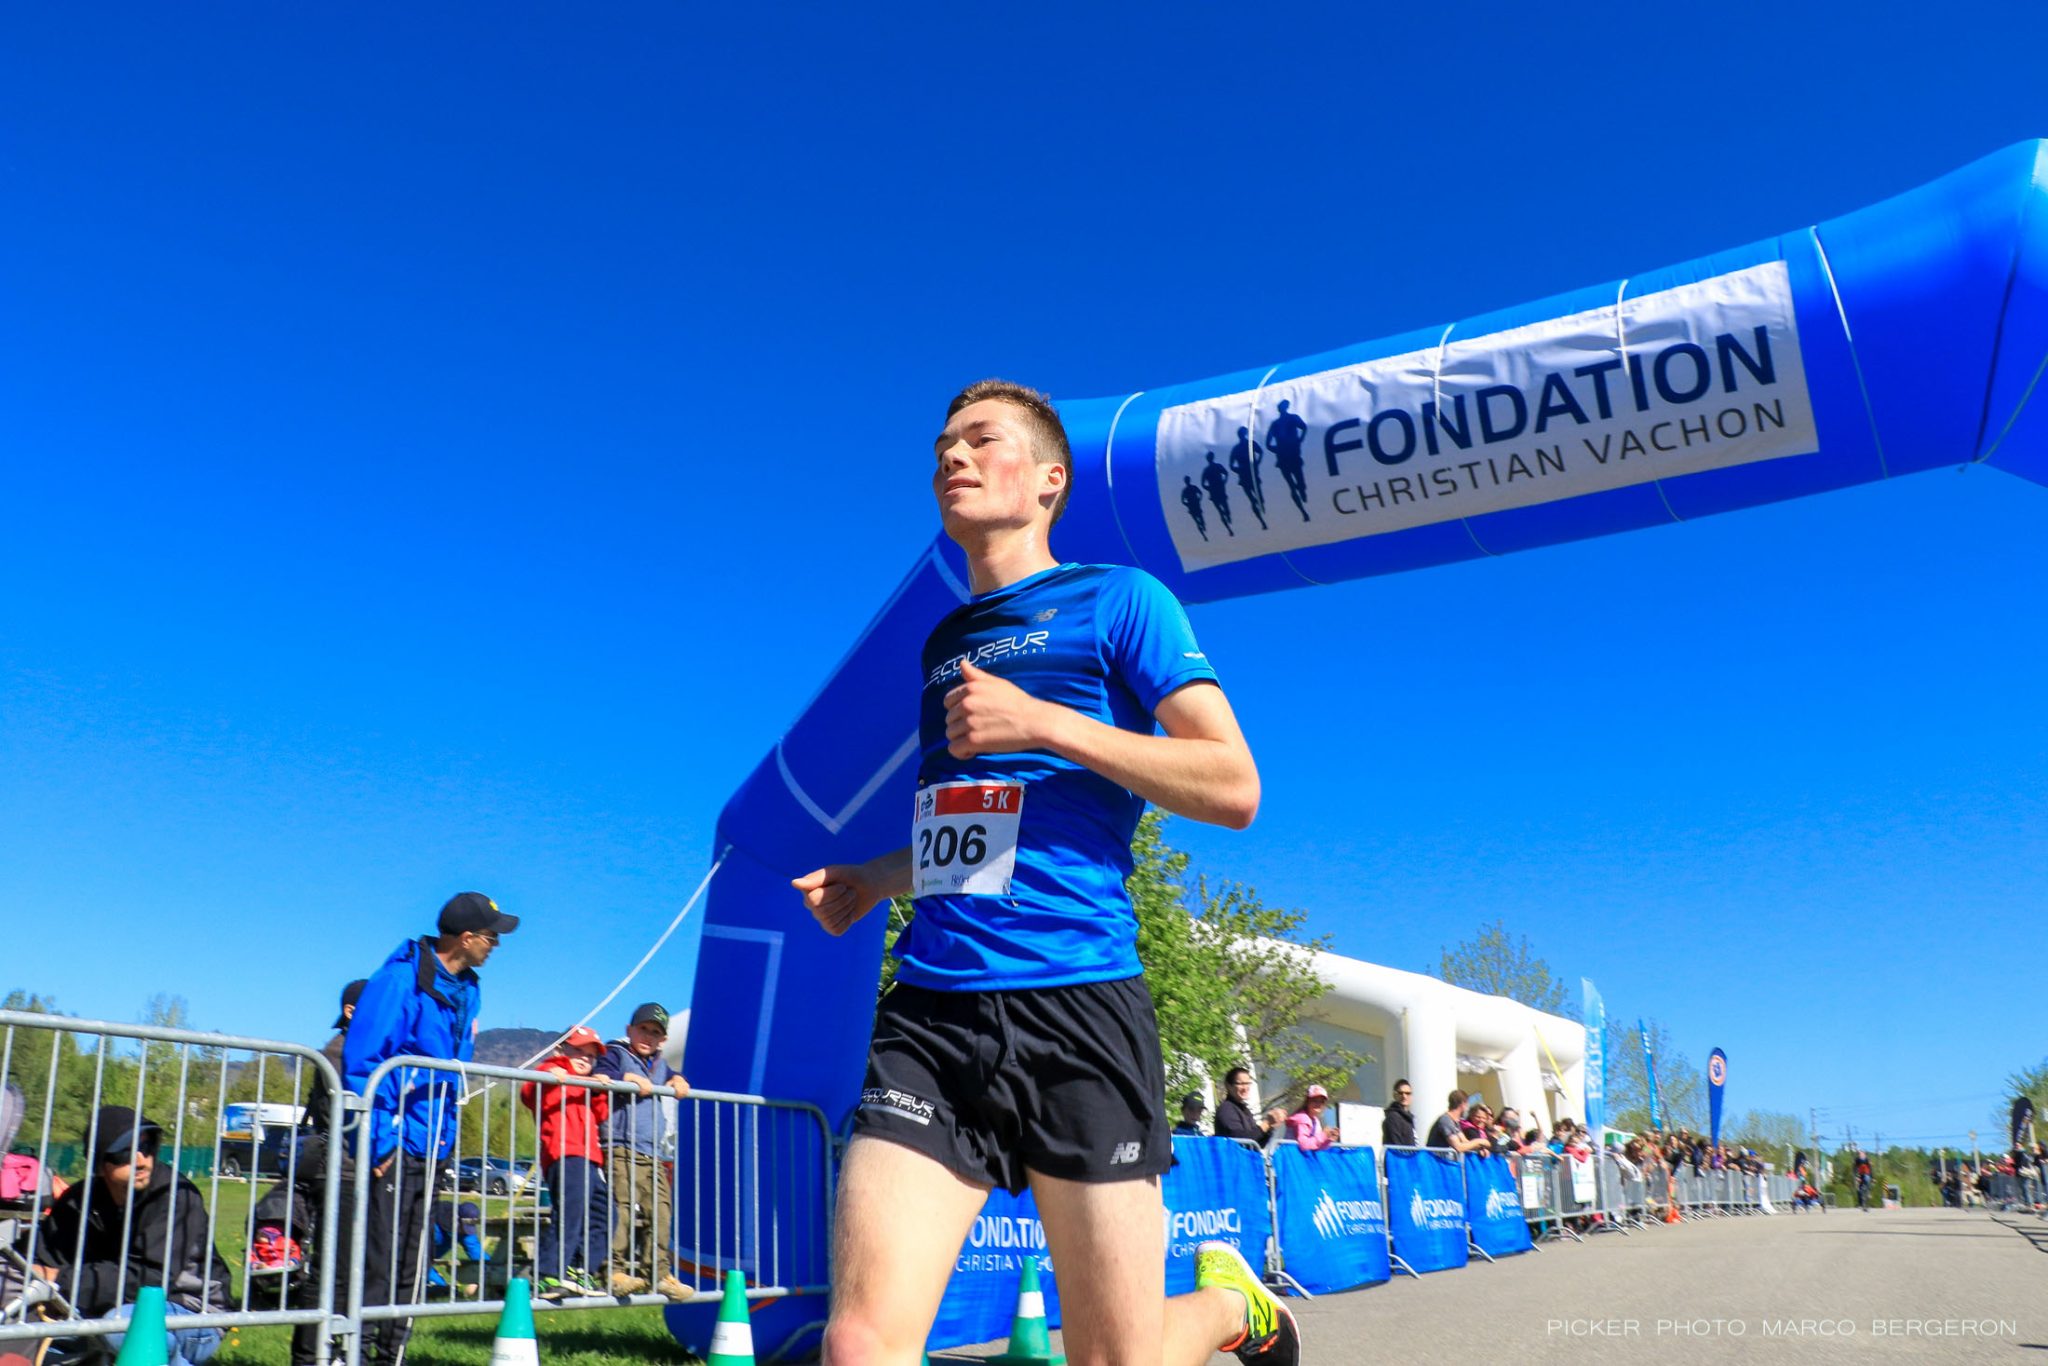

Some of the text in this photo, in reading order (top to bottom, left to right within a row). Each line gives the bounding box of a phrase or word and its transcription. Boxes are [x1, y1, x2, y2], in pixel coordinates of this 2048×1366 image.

[1324, 325, 1777, 477] FONDATION
[1331, 399, 1786, 515] CHRISTIAN VACHON
[919, 823, 987, 870] 206
[1110, 1141, 1141, 1165] NB
